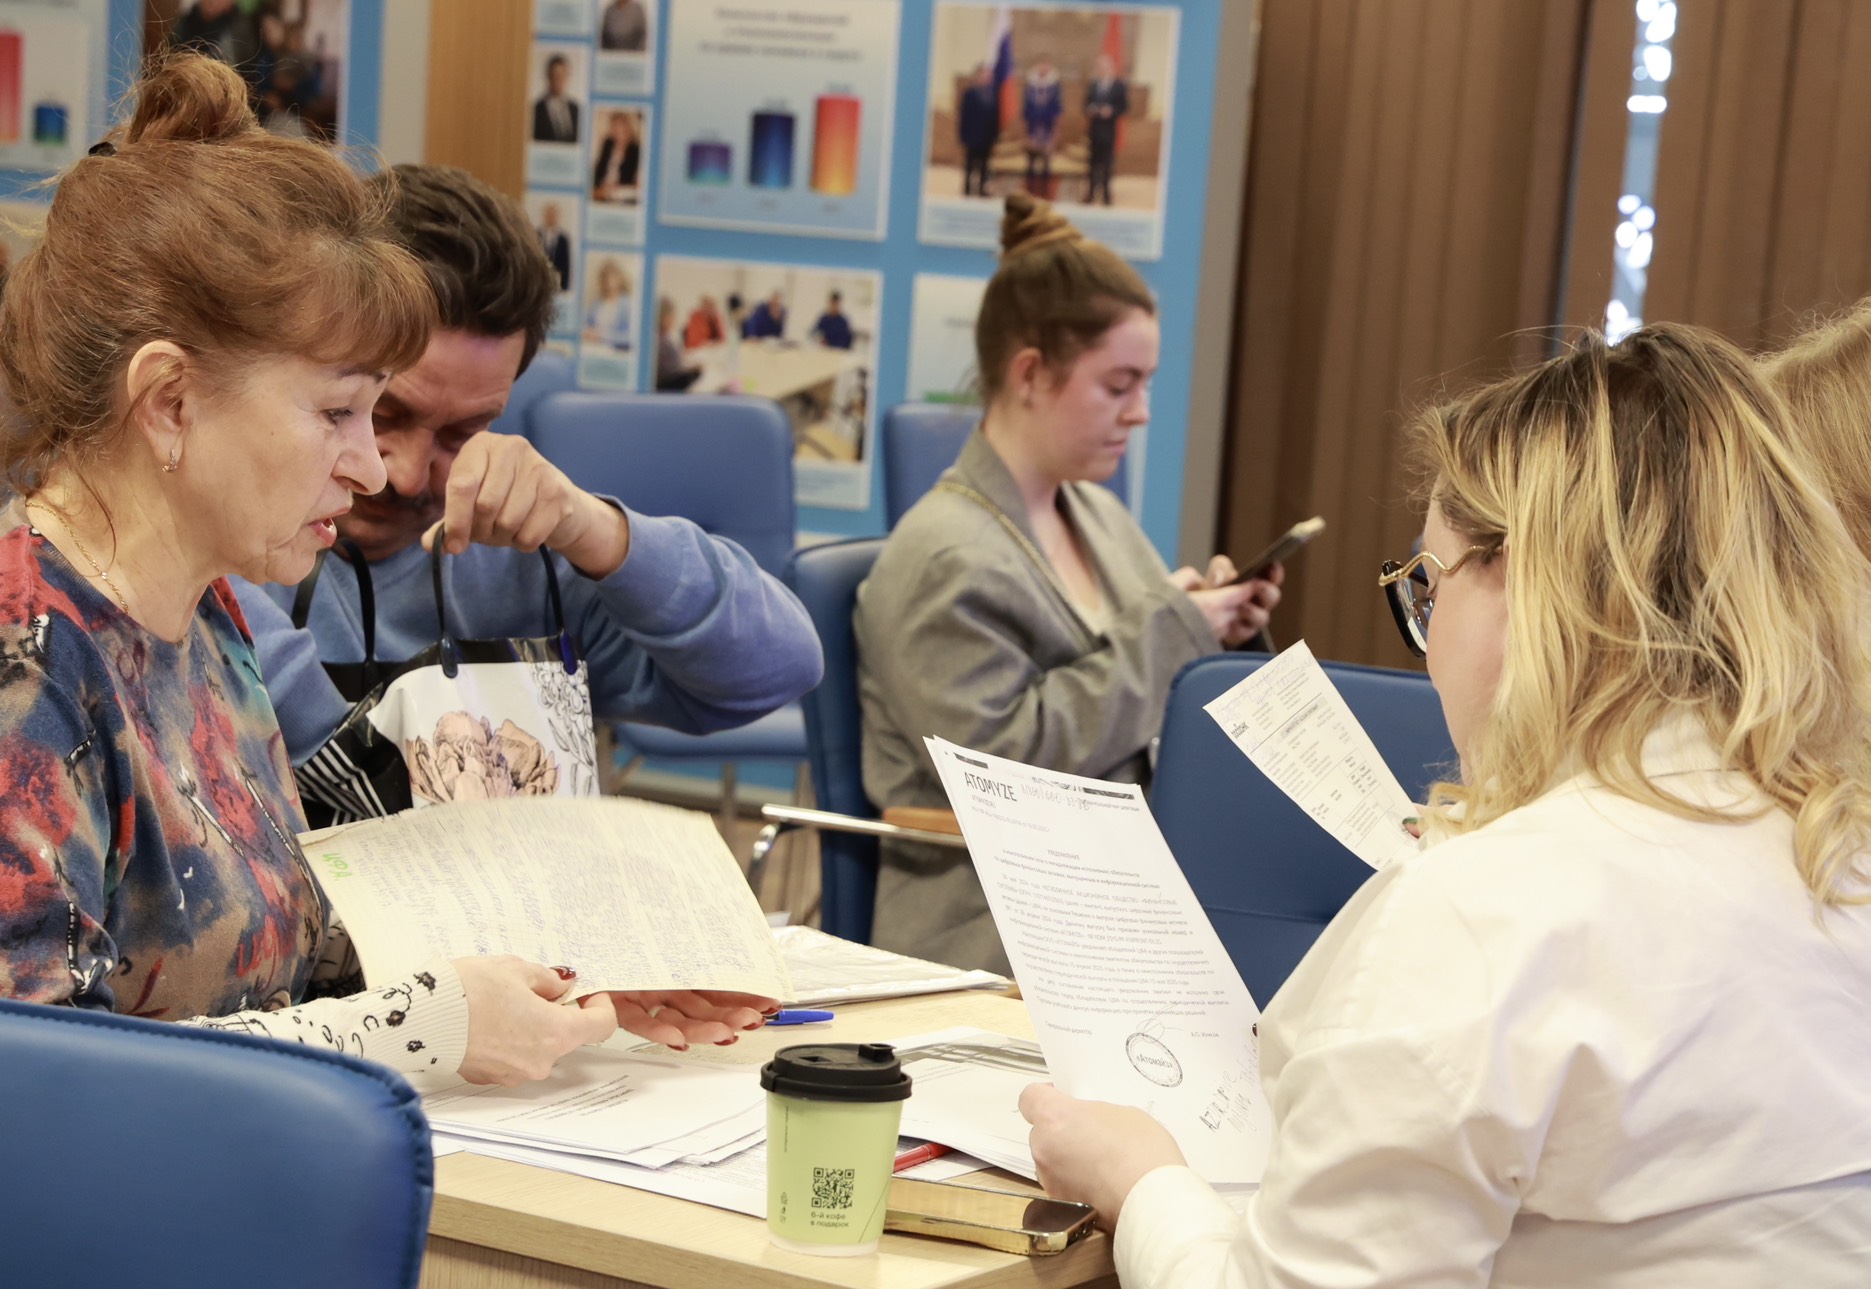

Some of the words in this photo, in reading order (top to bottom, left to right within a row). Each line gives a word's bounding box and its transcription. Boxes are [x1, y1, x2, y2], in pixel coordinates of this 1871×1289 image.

[964, 772, 1017, 802] ATOMYZE
[811, 1211, 825, 1219] 6-й
[826, 1212, 846, 1220] кофе
[817, 1220, 849, 1228] подарок
